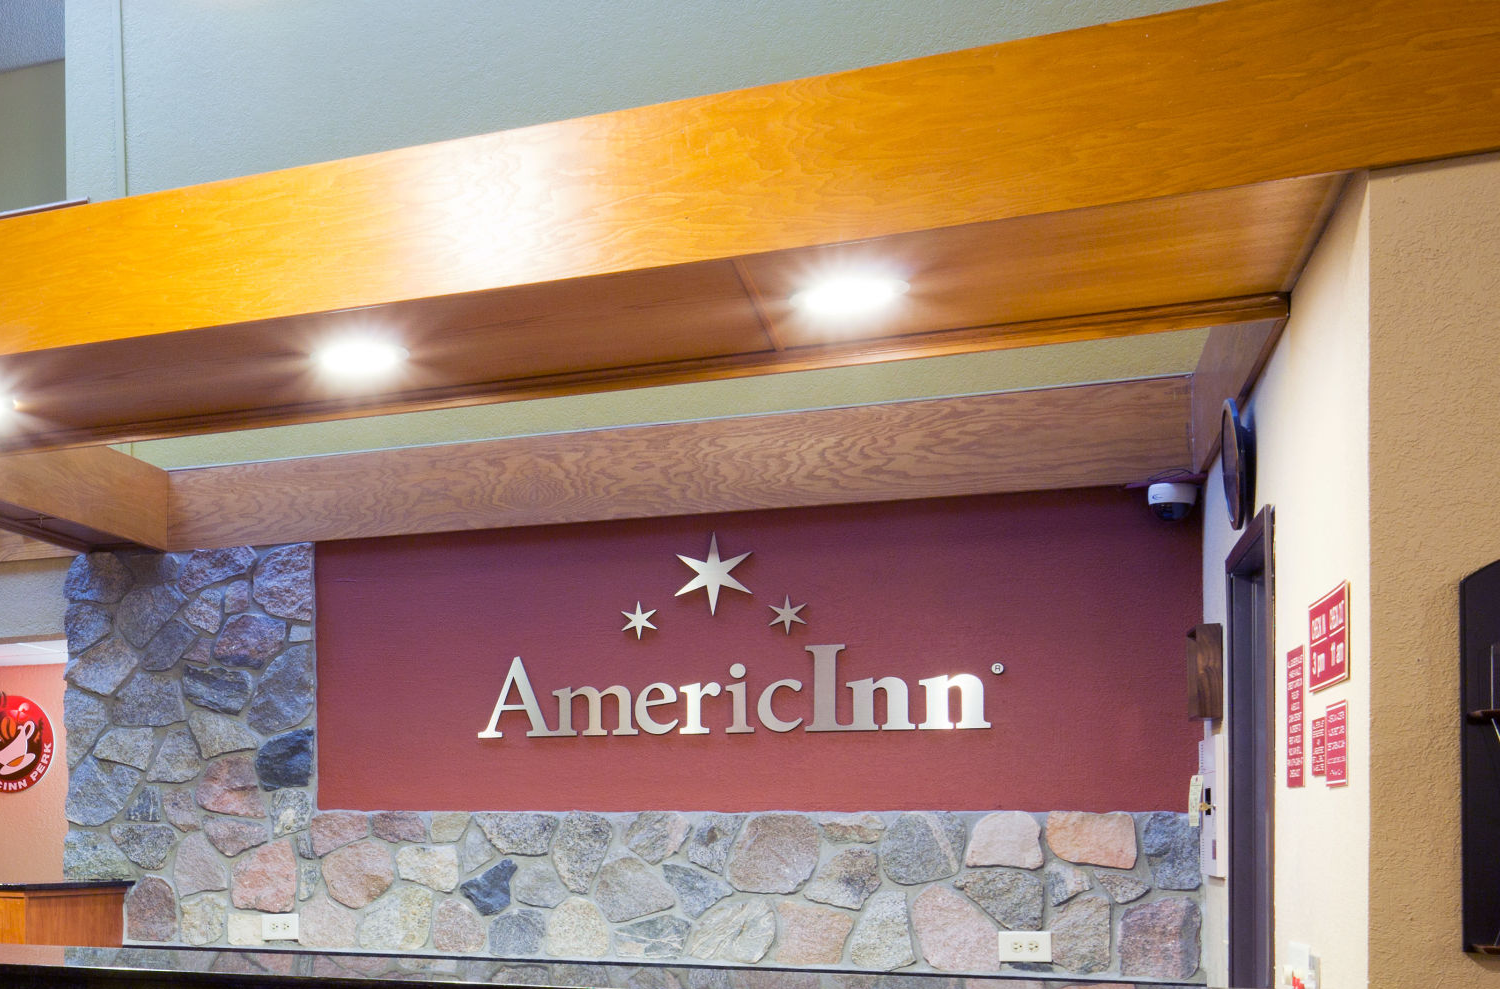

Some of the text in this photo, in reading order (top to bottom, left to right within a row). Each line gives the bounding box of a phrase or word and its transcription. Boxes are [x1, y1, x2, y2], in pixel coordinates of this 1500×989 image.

[1312, 651, 1317, 675] 3
[1317, 652, 1326, 678] pm
[29, 742, 52, 782] PERK
